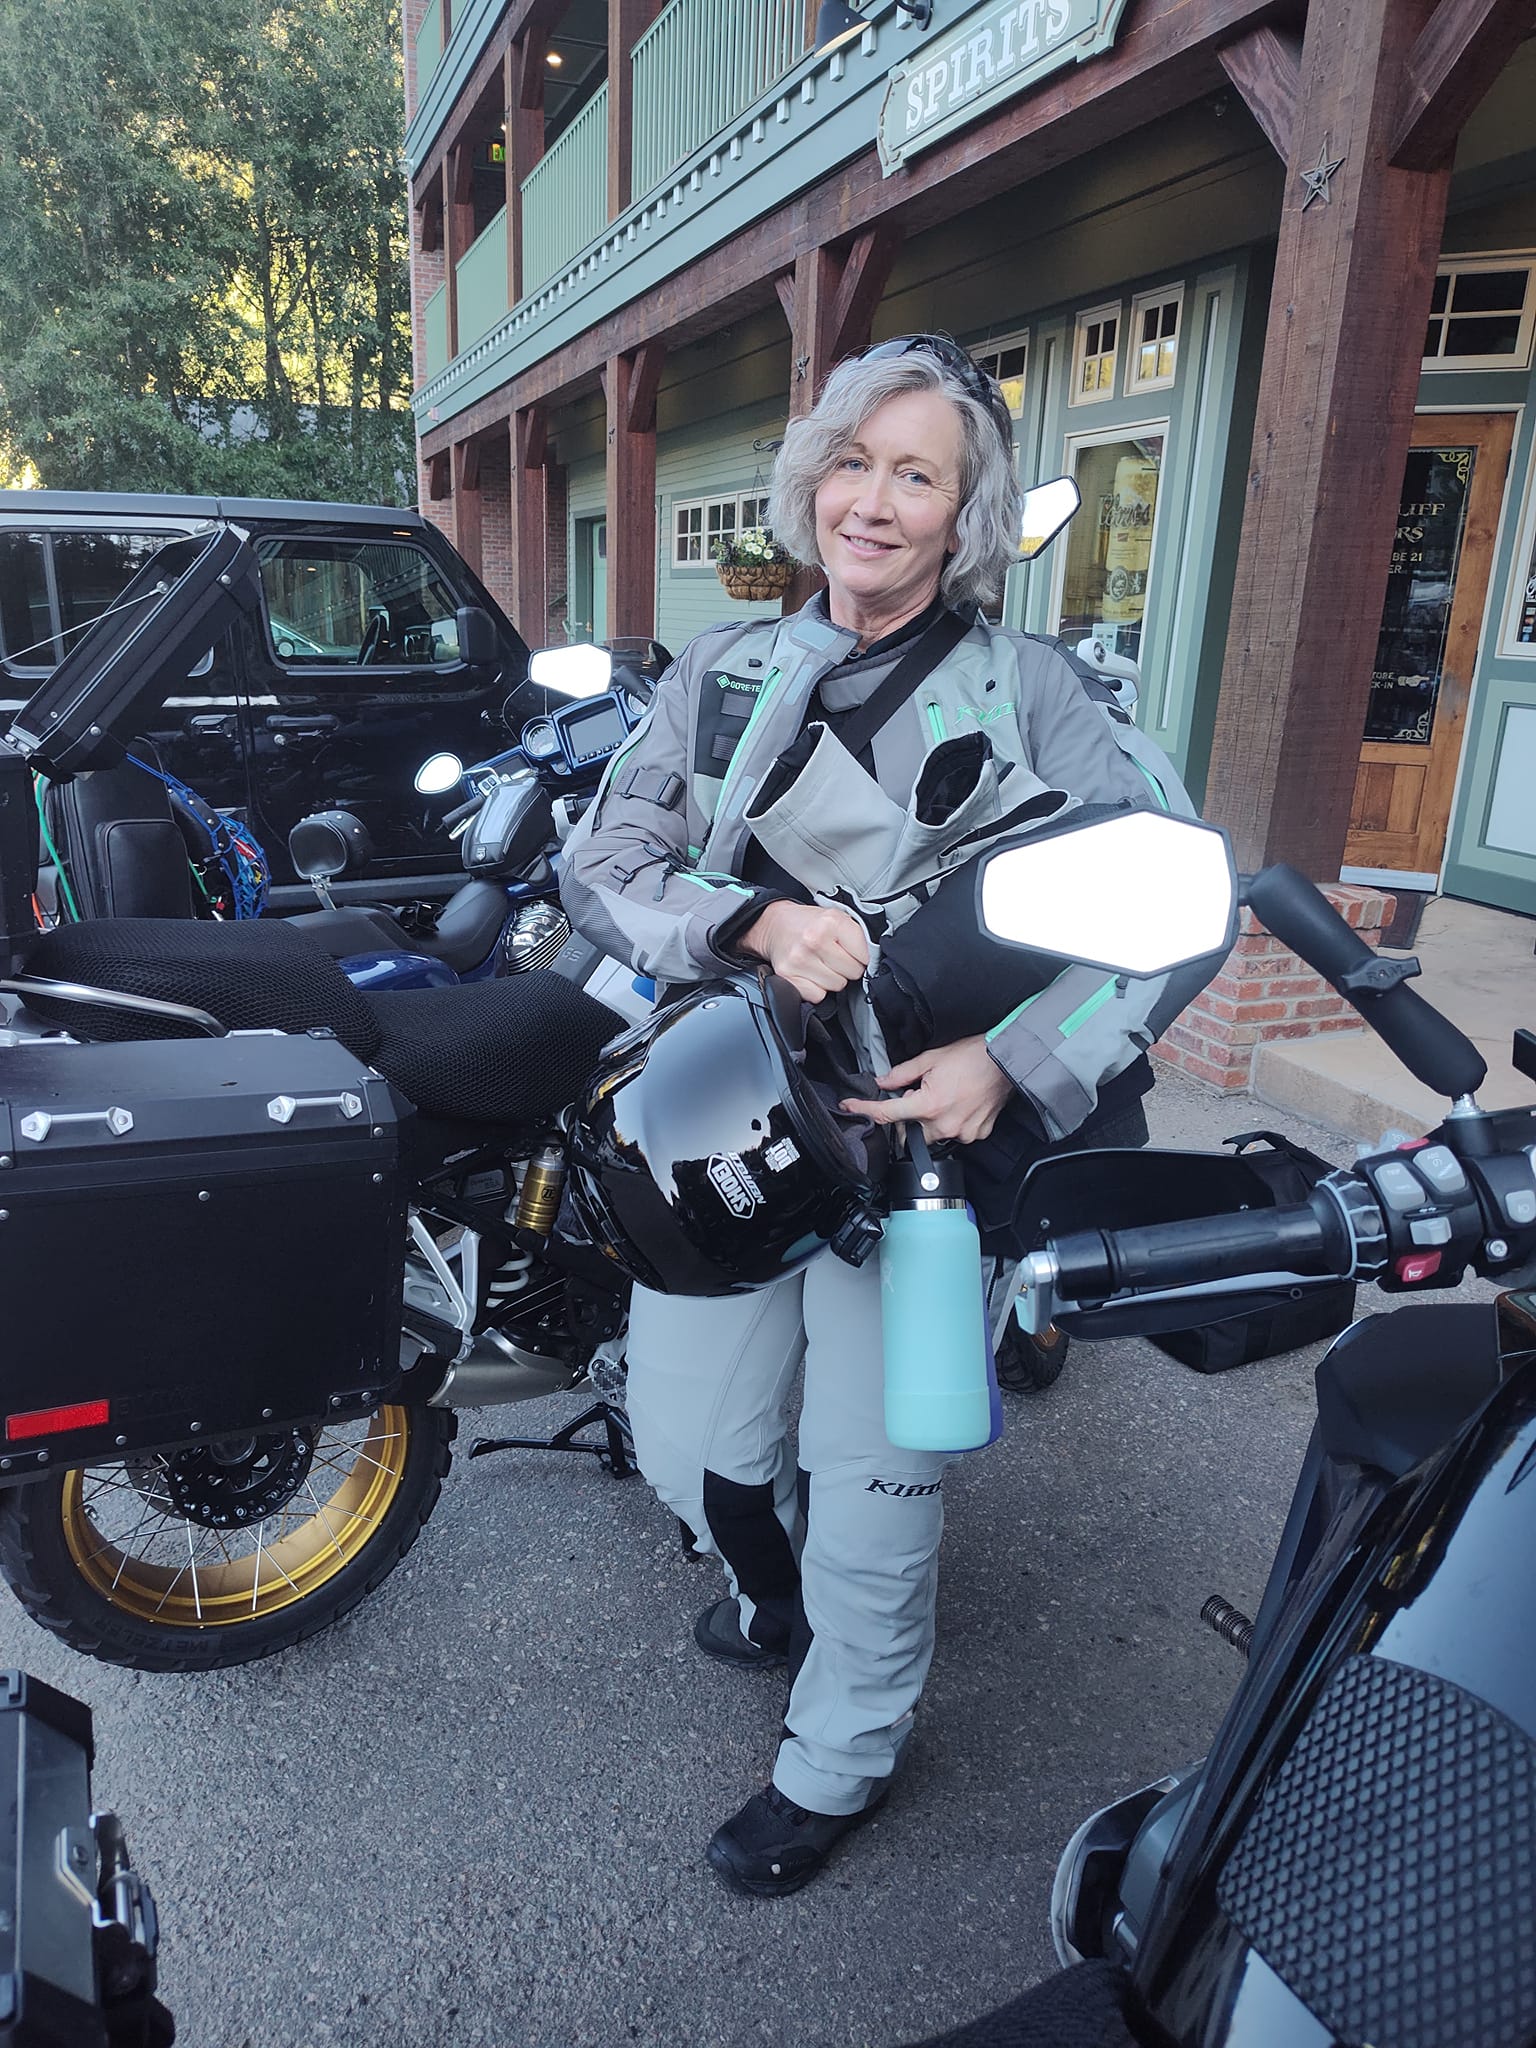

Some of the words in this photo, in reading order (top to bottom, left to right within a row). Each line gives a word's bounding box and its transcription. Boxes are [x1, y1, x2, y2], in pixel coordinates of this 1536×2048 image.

[906, 0, 1071, 131] SPIRITS
[1399, 503, 1446, 517] LIFF
[1410, 552, 1423, 562] 21
[1372, 671, 1395, 680] TORE
[730, 681, 761, 693] GORE-TE
[710, 1161, 751, 1213] SHOEI
